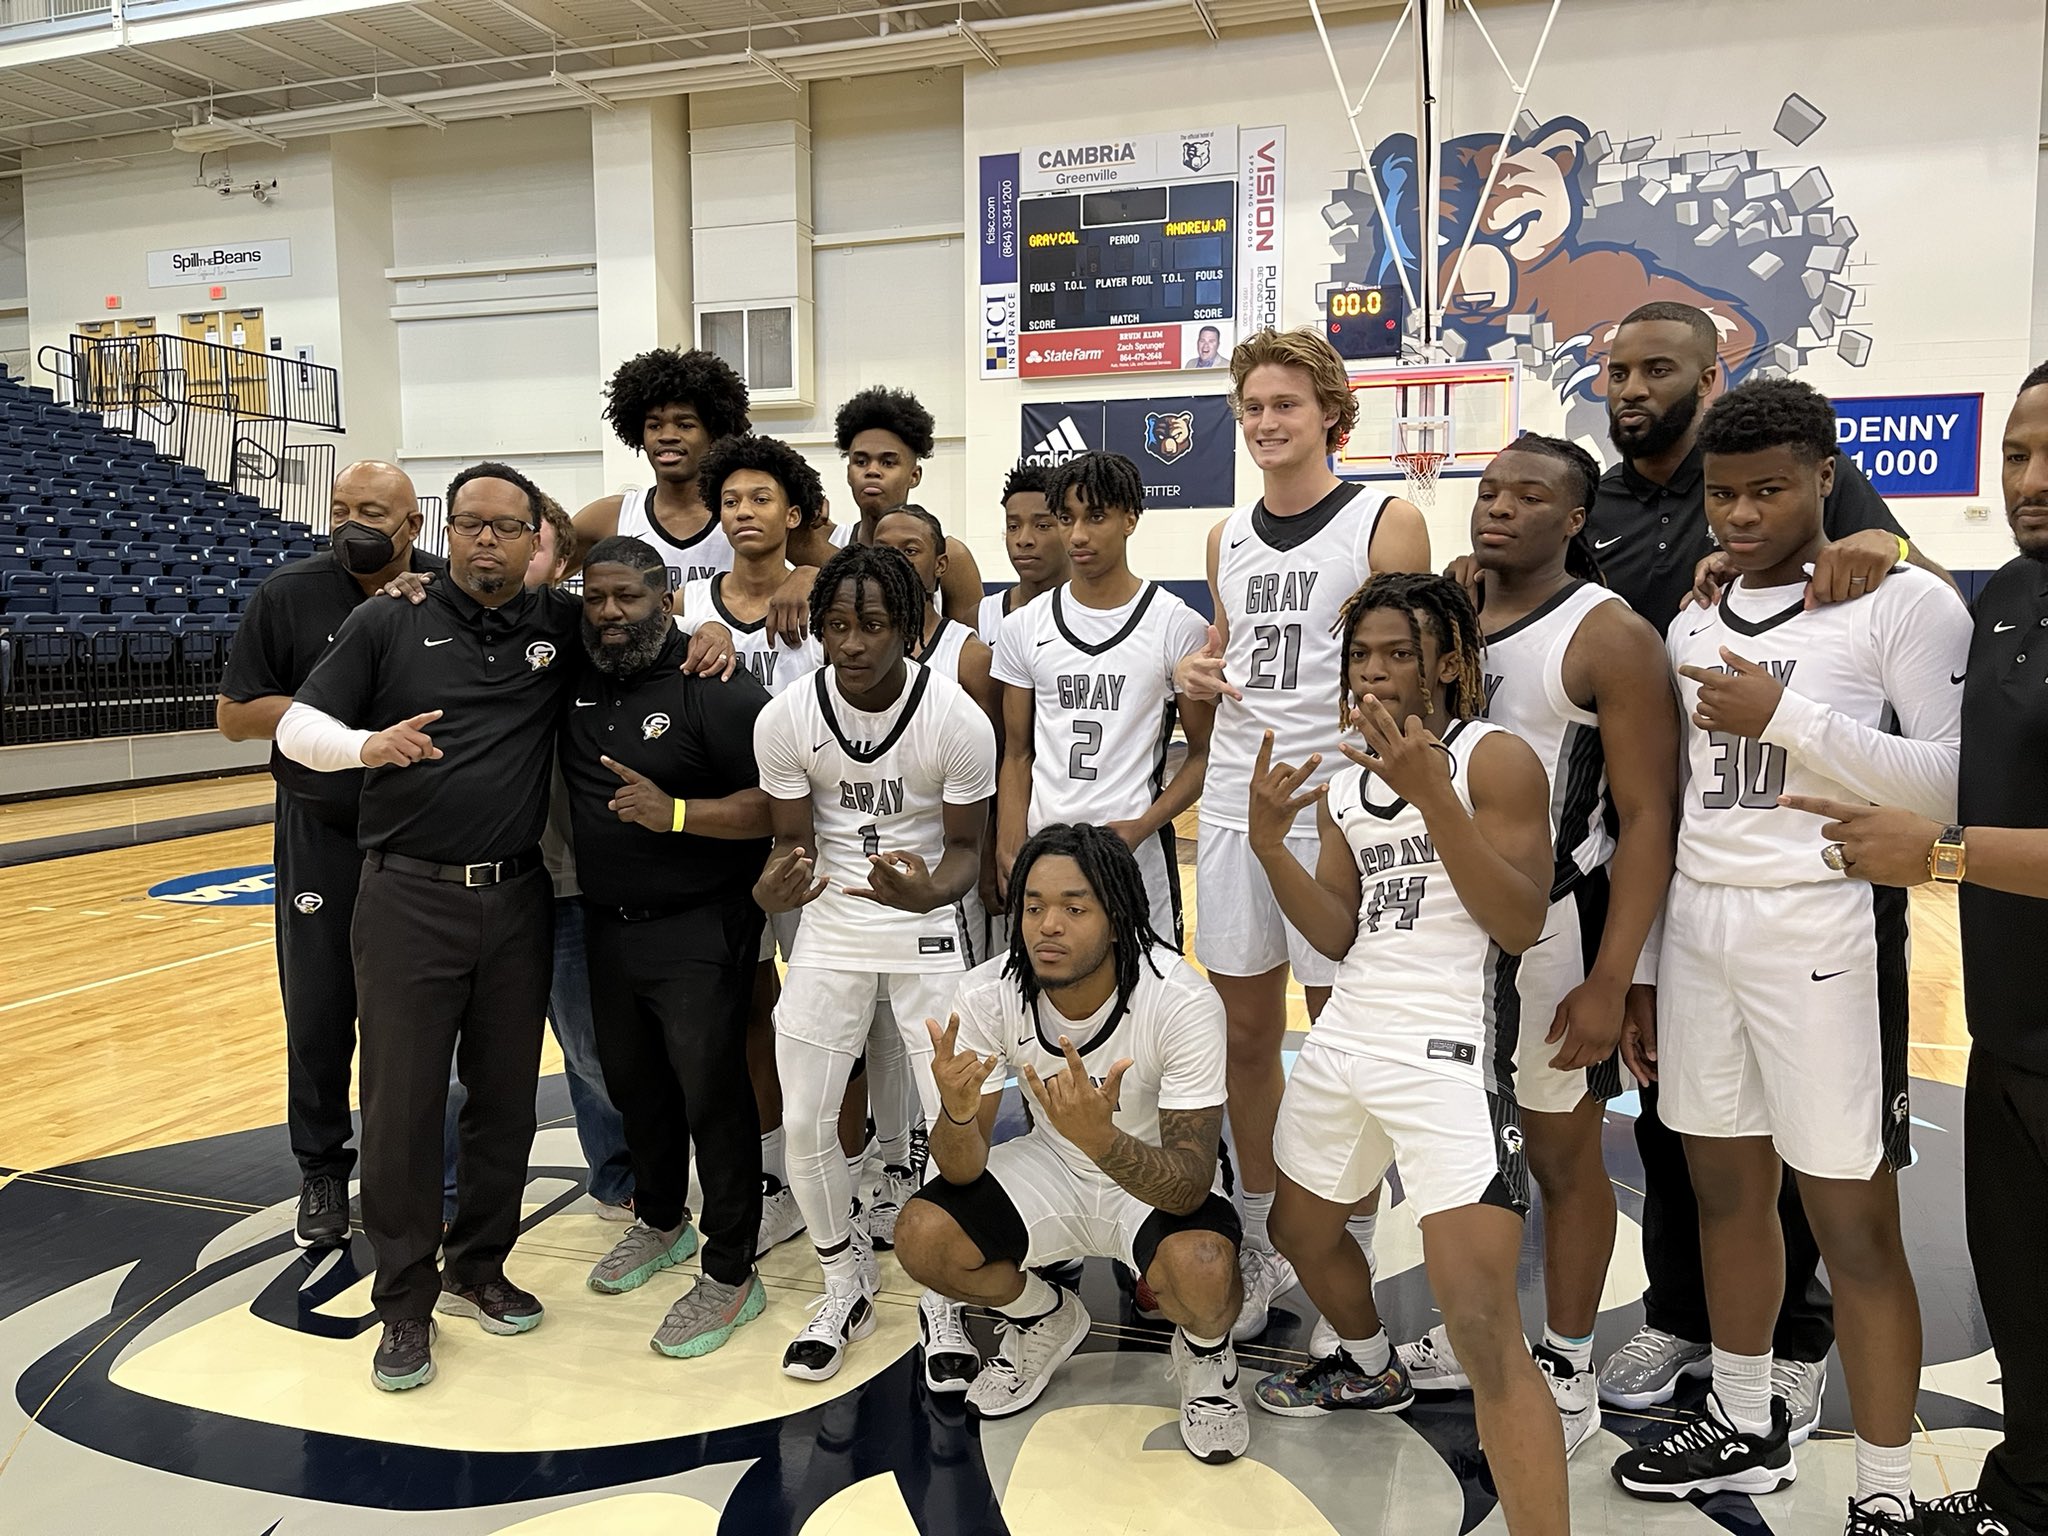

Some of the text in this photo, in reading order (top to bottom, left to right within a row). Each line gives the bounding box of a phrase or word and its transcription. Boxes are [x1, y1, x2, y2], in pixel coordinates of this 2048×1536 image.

[1056, 169, 1117, 185] Greenville
[1256, 140, 1276, 251] VISION
[985, 196, 995, 245] fcisc.com
[1002, 180, 1014, 258] (864) 334-1200
[1166, 220, 1210, 236] ANDREW
[1109, 234, 1140, 246] PERIOD
[1029, 281, 1056, 293] FOULS
[1063, 279, 1087, 291] T.O.L.
[1095, 275, 1154, 289] PLAYER FOUL
[1161, 272, 1185, 284] T.O.L.
[1195, 269, 1223, 281] FOULS
[1193, 308, 1223, 320] SCORE
[1332, 291, 1381, 317] 00.0
[986, 296, 1006, 345] FCI
[1008, 292, 1016, 369] INSURANCE
[1028, 319, 1056, 331] SCORE
[1109, 314, 1140, 325] MATCH
[1117, 342, 1165, 352] Zach Sprunger
[1835, 414, 1960, 444] DENNY
[1026, 449, 1086, 468] adid
[666, 566, 717, 595] RAY
[1245, 571, 1319, 615] GRAY
[1246, 623, 1302, 690] 21
[1057, 673, 1126, 711] GRAY
[1069, 719, 1103, 781] 2
[1702, 728, 1788, 810] 30
[839, 777, 904, 816] GRAY
[858, 824, 880, 858] 1
[1360, 833, 1435, 876] GRAY
[1367, 876, 1428, 933] 14
[1459, 1048, 1468, 1058] S
